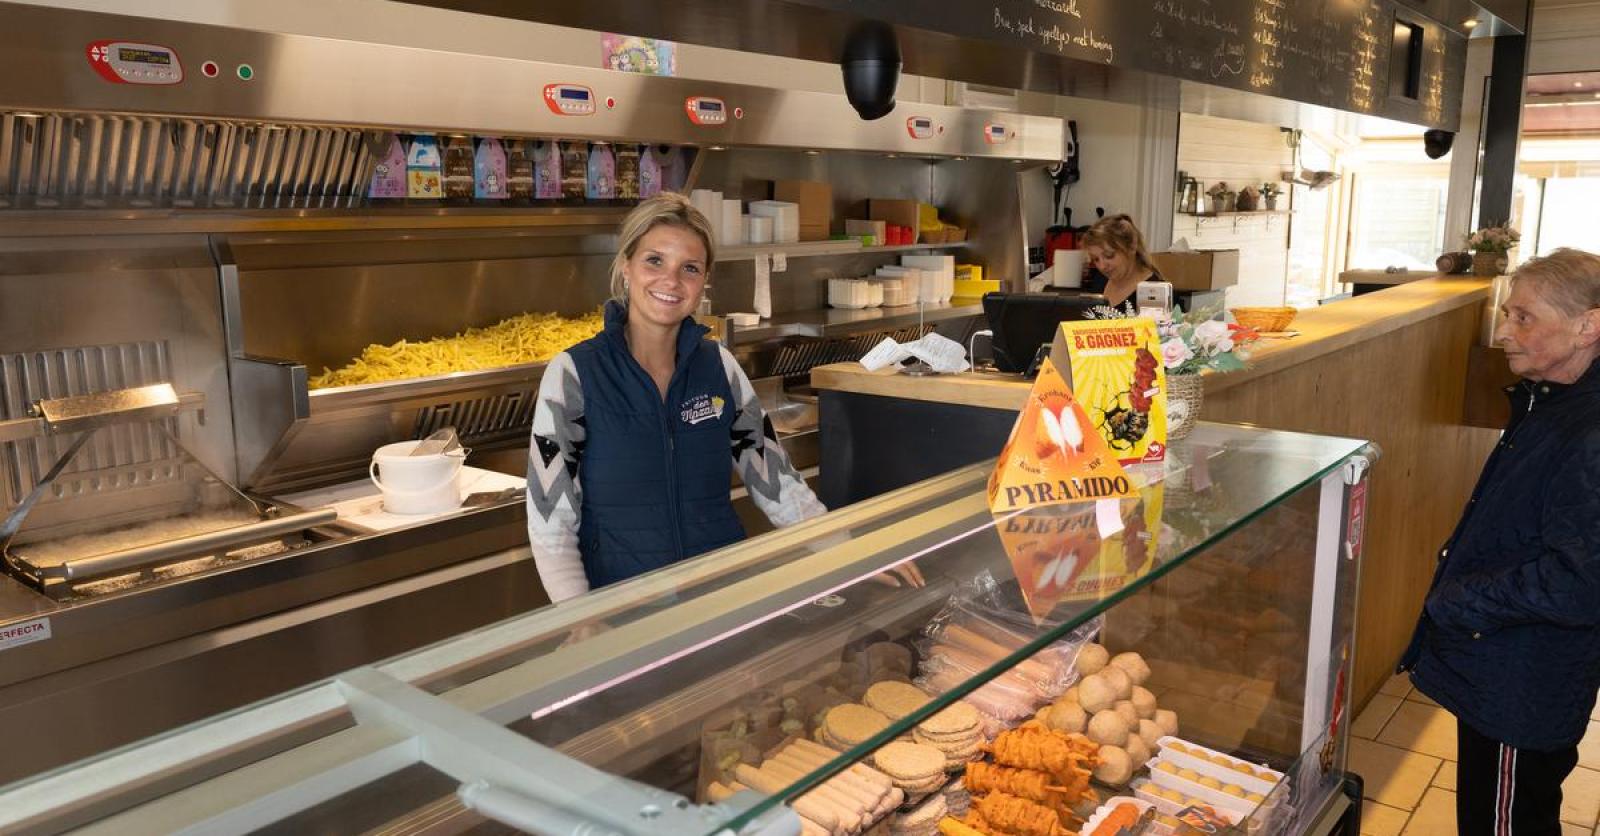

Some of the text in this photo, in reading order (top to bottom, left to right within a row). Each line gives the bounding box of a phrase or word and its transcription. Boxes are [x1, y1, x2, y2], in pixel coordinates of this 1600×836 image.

[1074, 332, 1137, 350] & GAGNEZ
[1004, 475, 1130, 507] PYRAMIDO
